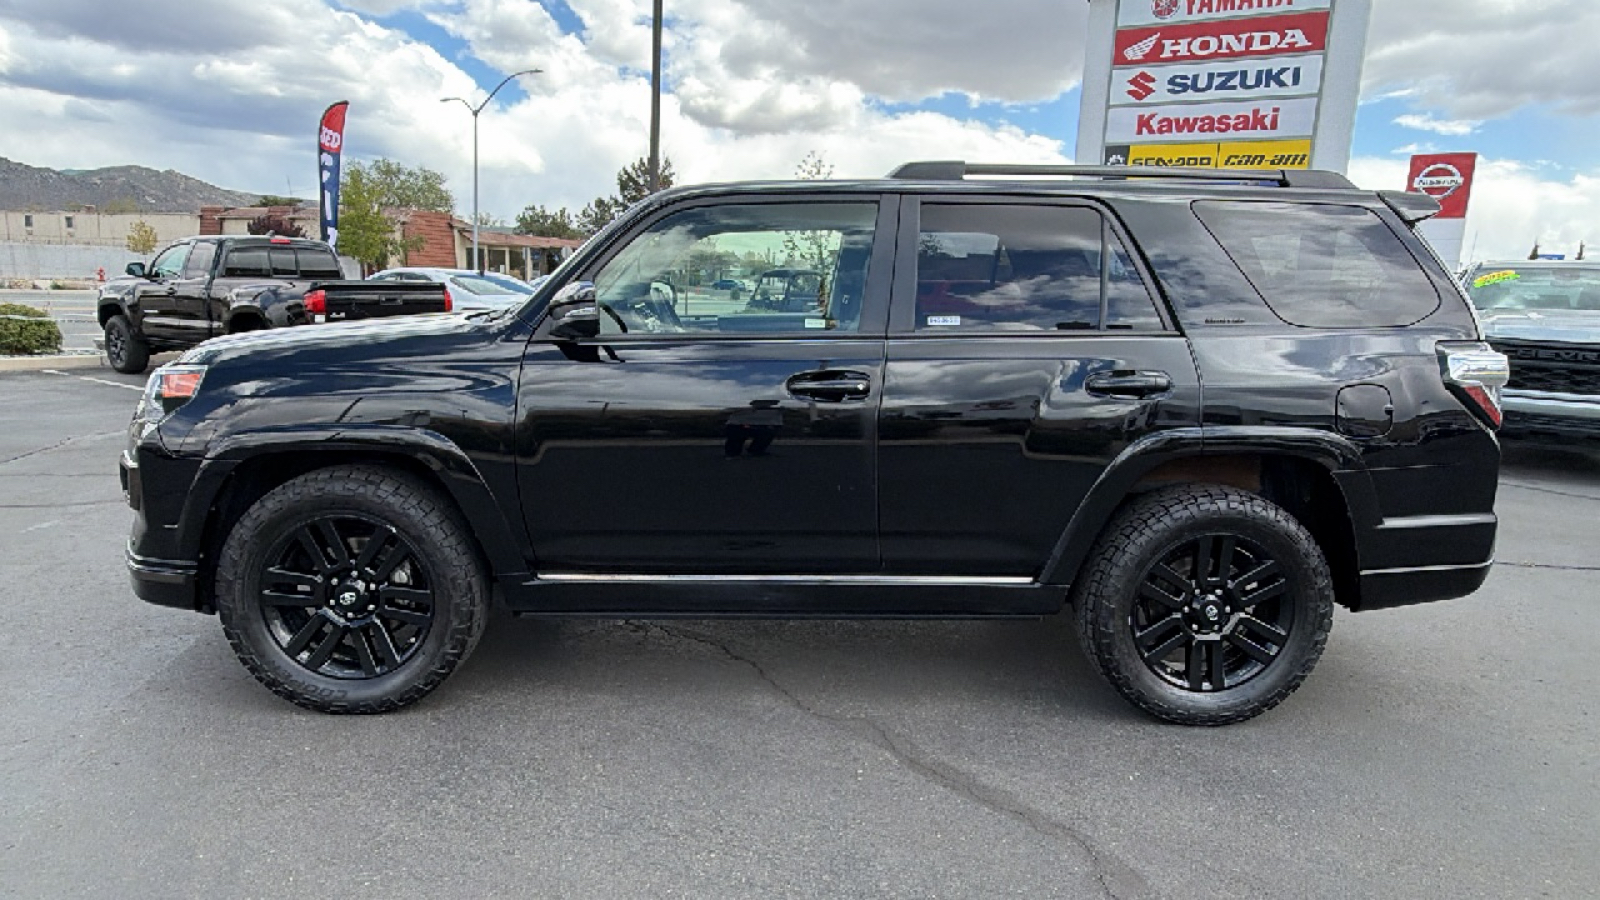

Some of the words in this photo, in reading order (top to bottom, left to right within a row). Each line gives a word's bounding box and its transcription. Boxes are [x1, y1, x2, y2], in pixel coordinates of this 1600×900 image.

[1186, 0, 1294, 15] YAMA
[1159, 29, 1312, 58] HONDA
[1167, 66, 1301, 94] SUZUKI
[1136, 107, 1280, 135] Kawasaki
